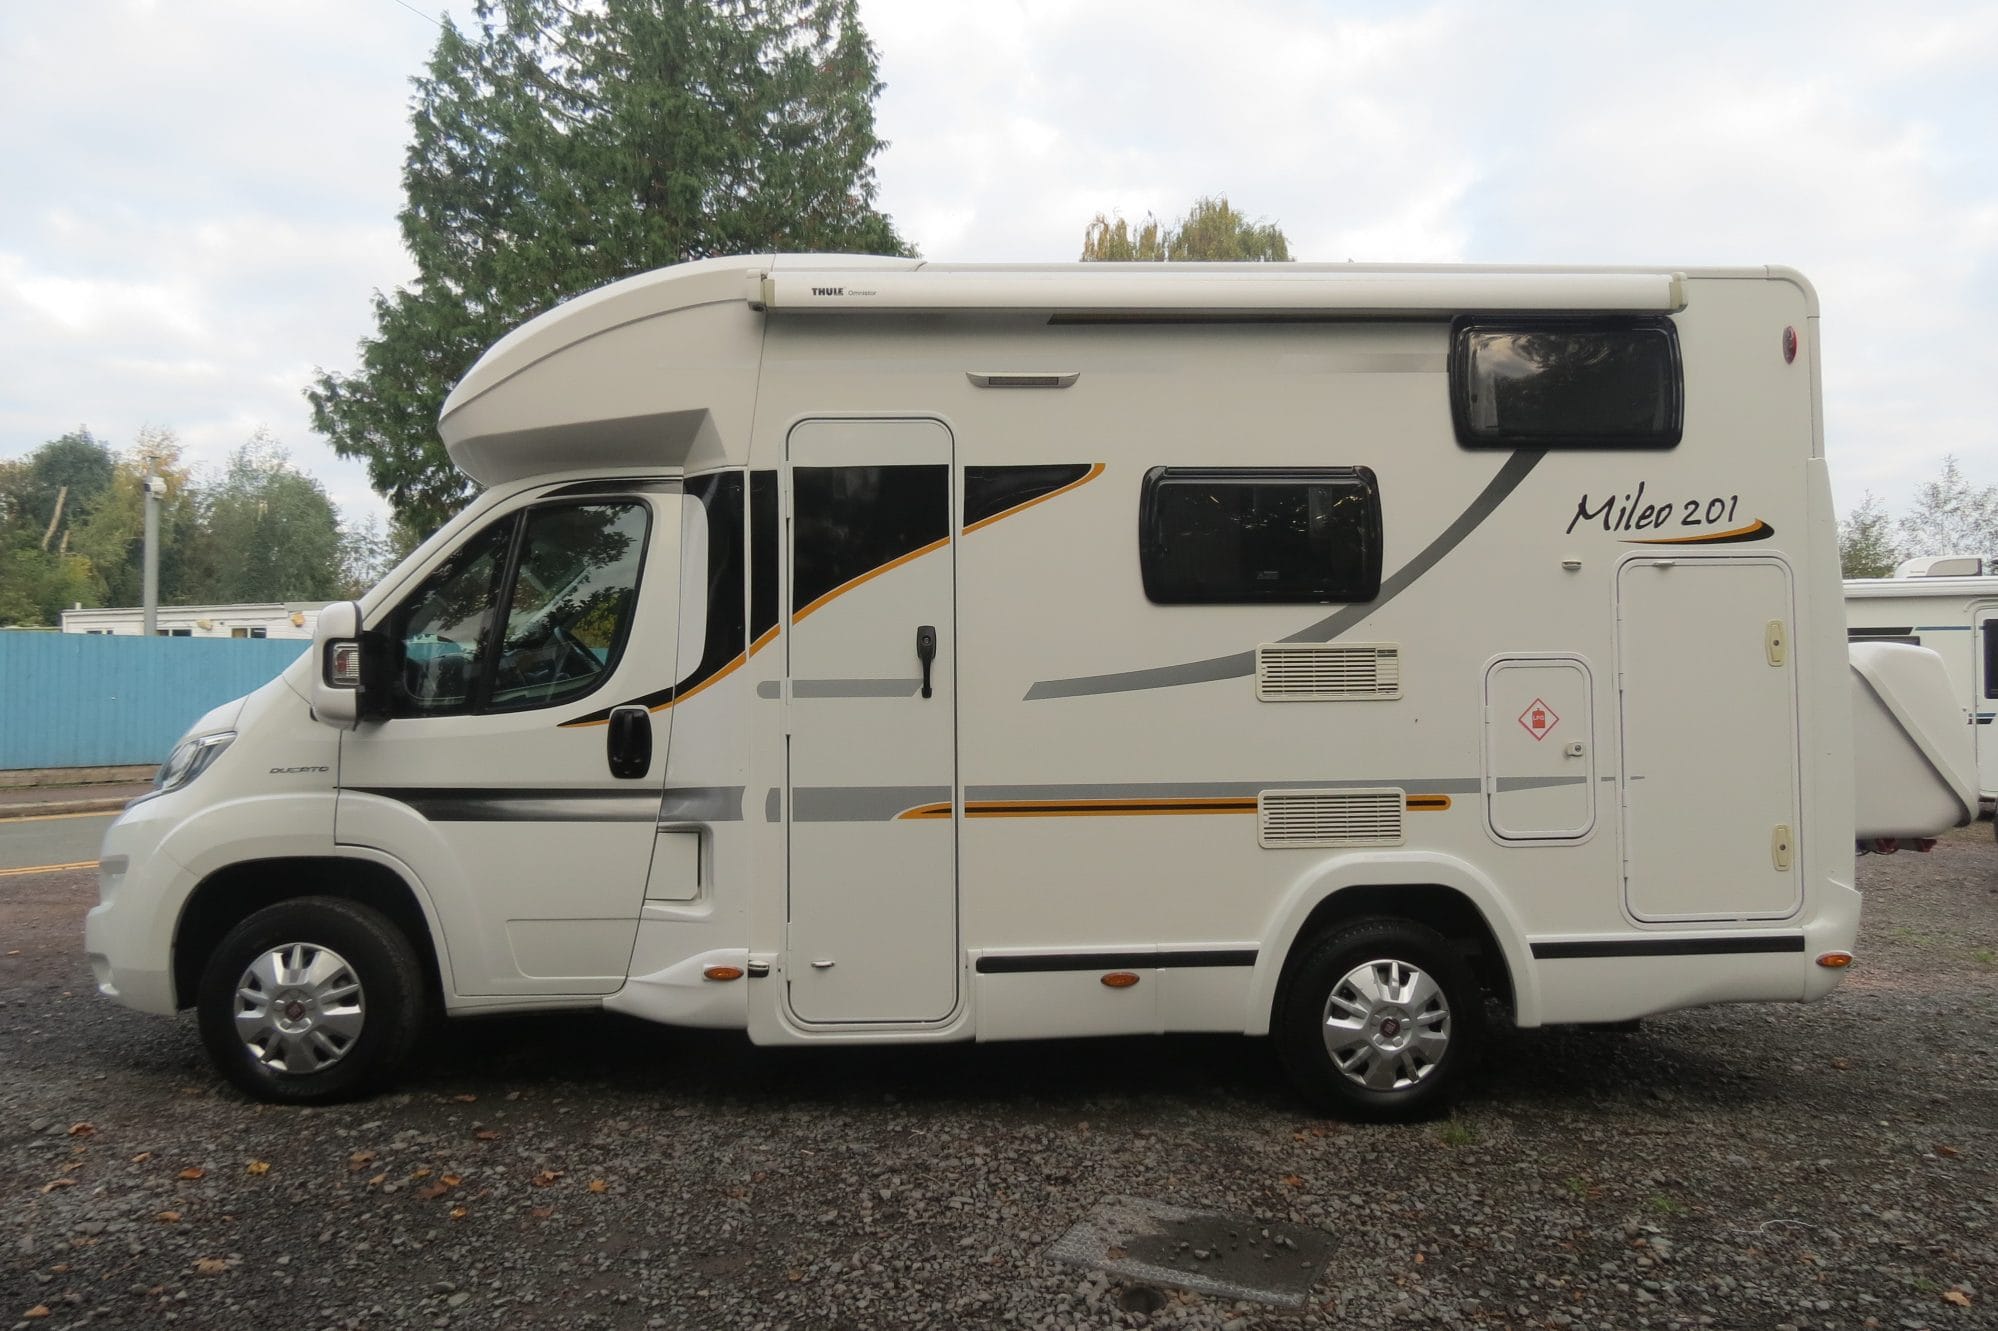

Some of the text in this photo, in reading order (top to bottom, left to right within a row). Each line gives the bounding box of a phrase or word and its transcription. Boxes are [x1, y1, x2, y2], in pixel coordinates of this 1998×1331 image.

[811, 287, 844, 296] THULE
[1566, 480, 1738, 535] Mileo 201
[269, 766, 329, 774] DUCATO
